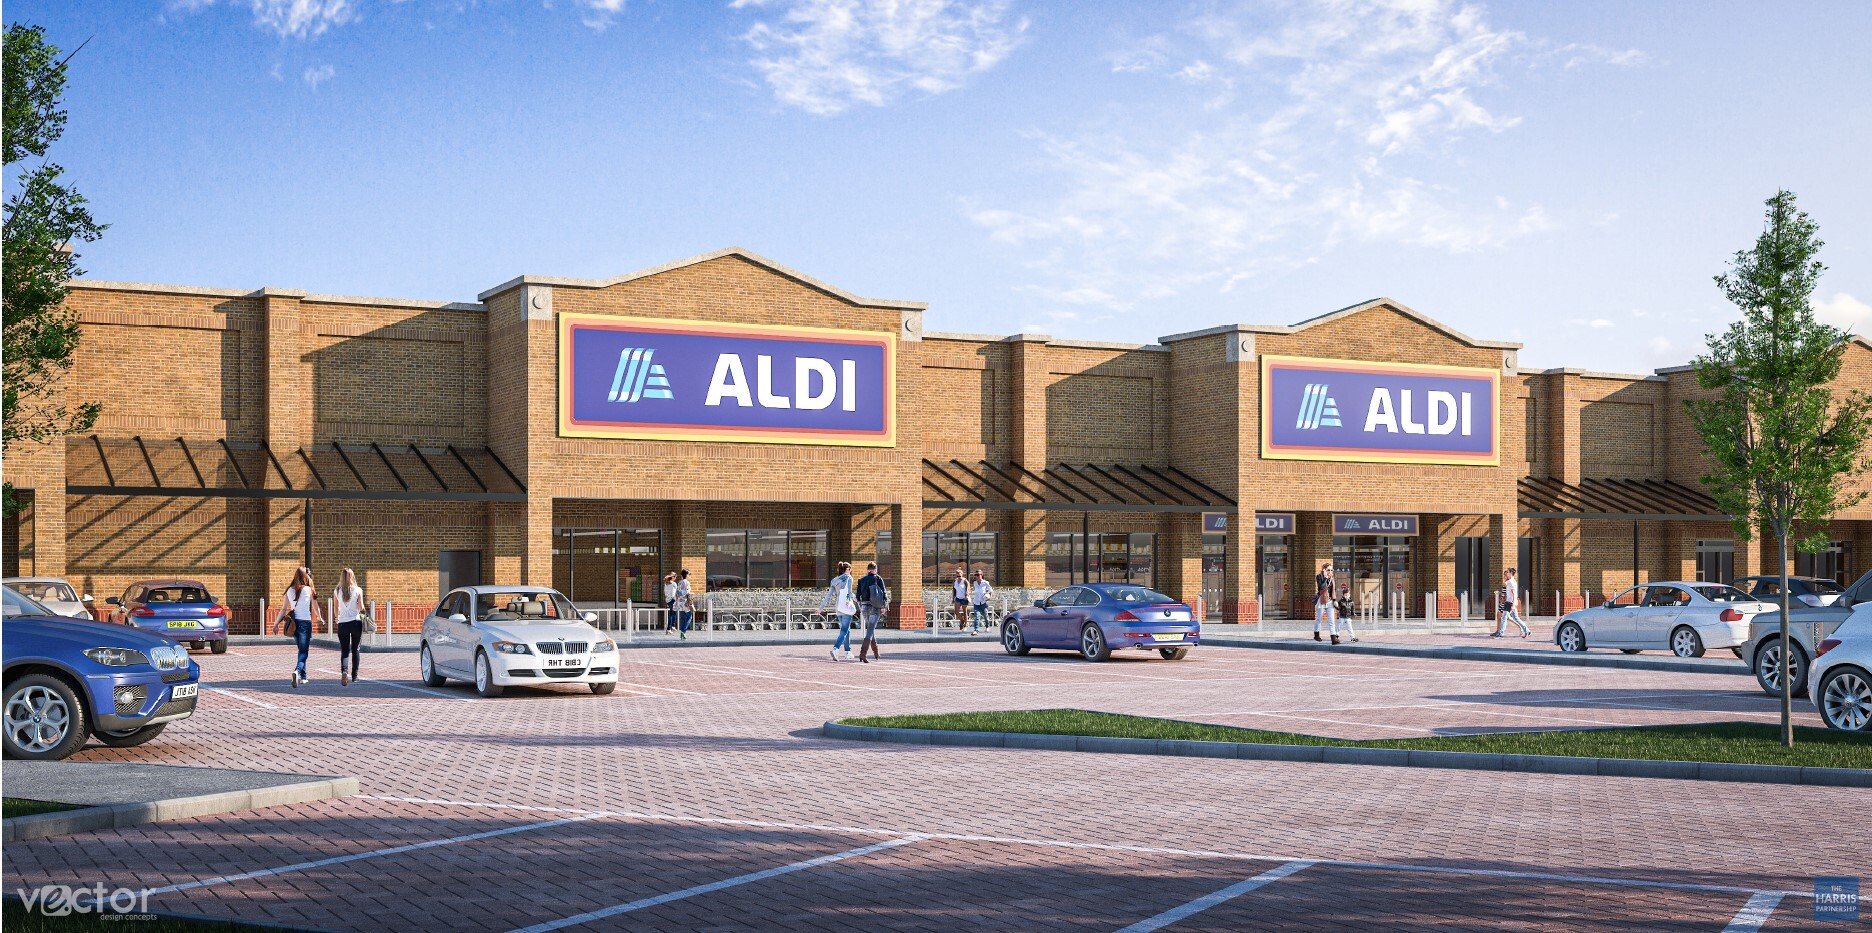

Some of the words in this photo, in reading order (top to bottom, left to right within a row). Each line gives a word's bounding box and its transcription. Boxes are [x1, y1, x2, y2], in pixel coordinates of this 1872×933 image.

[704, 353, 856, 412] ALDI
[1363, 387, 1472, 436] ALDI
[1256, 517, 1284, 529] LDI
[1368, 519, 1408, 530] ALDI
